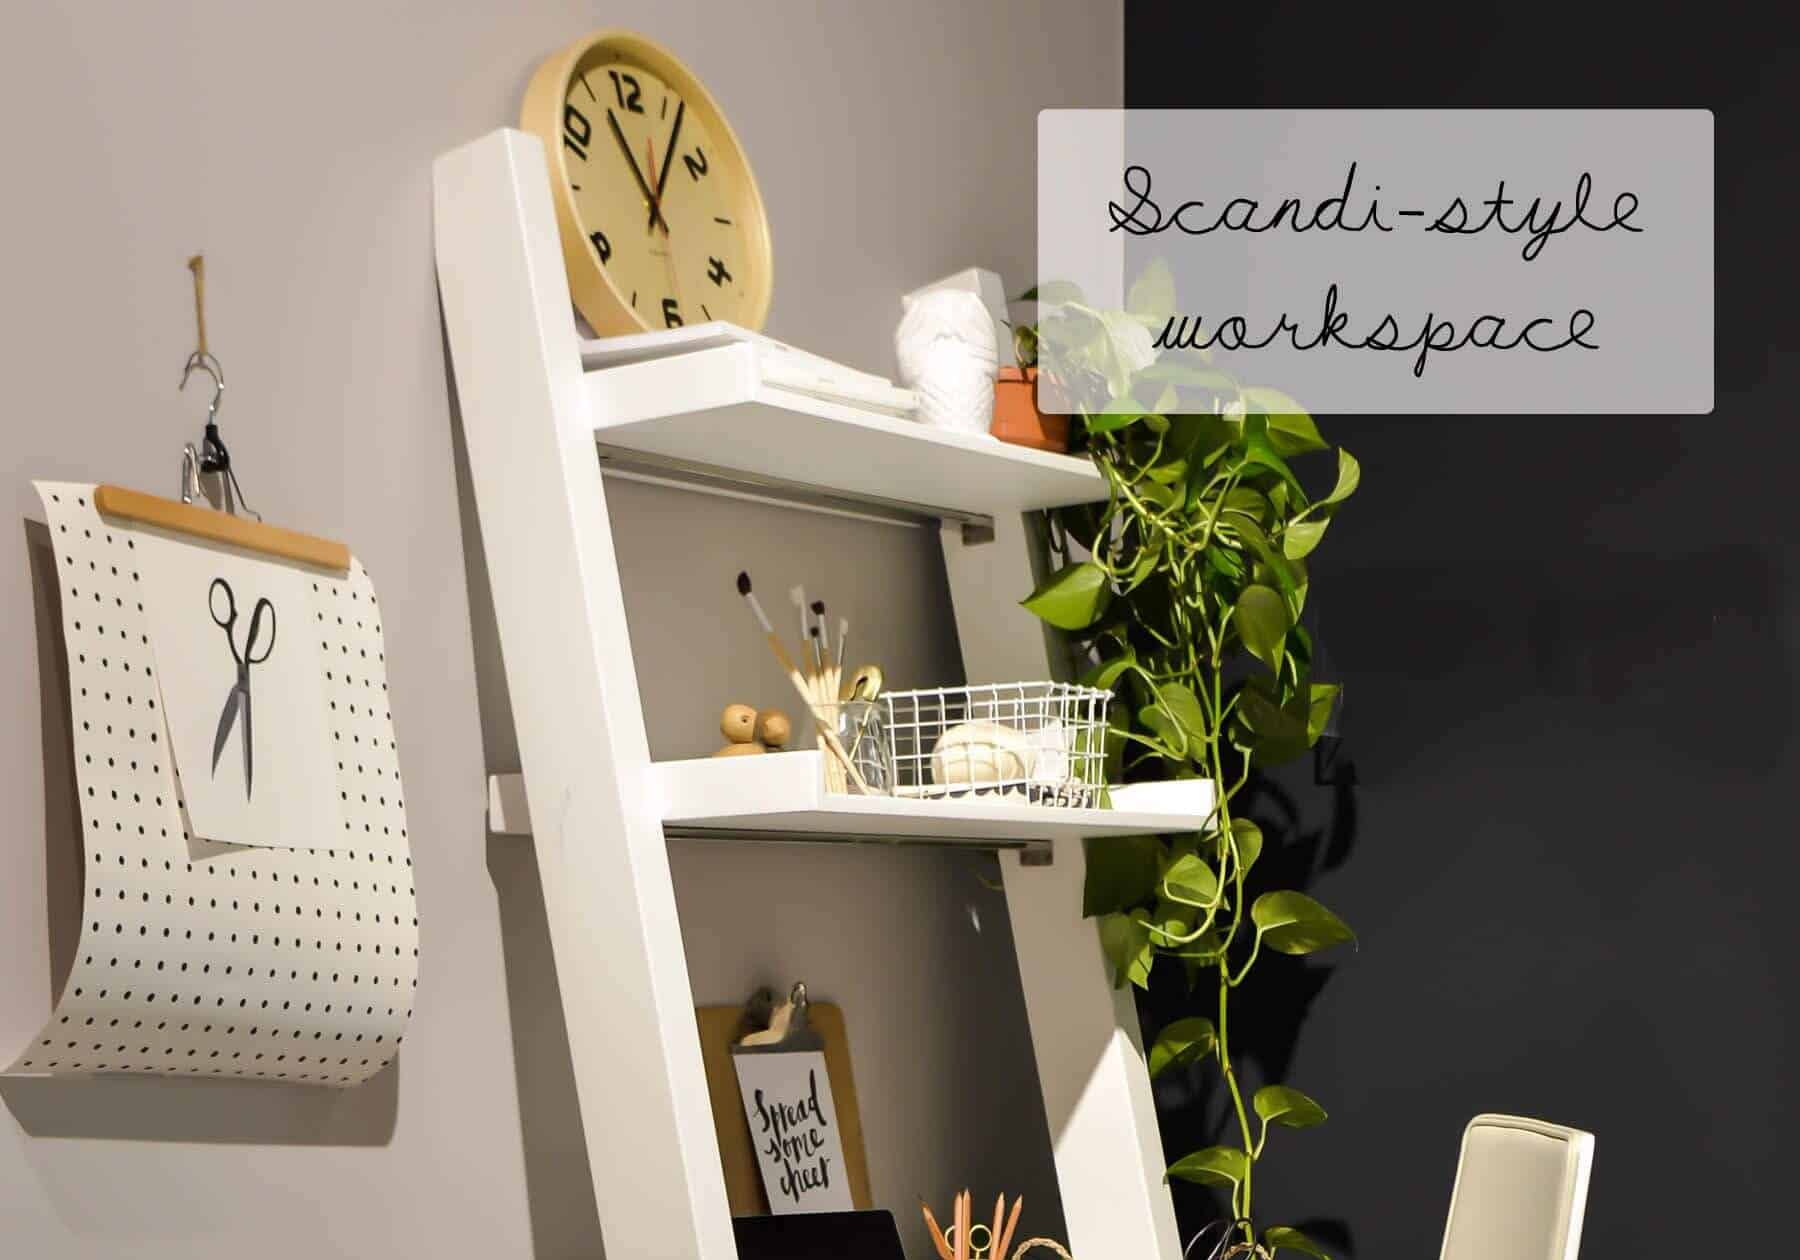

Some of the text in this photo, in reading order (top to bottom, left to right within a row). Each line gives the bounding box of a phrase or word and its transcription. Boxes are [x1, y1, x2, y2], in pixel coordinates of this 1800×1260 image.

[608, 69, 645, 115] 12
[563, 103, 592, 162] 10
[682, 146, 709, 182] 2
[707, 256, 733, 287] 4
[753, 1068, 827, 1144] Spread
[764, 1128, 825, 1165] some
[780, 1156, 830, 1204] cheer
